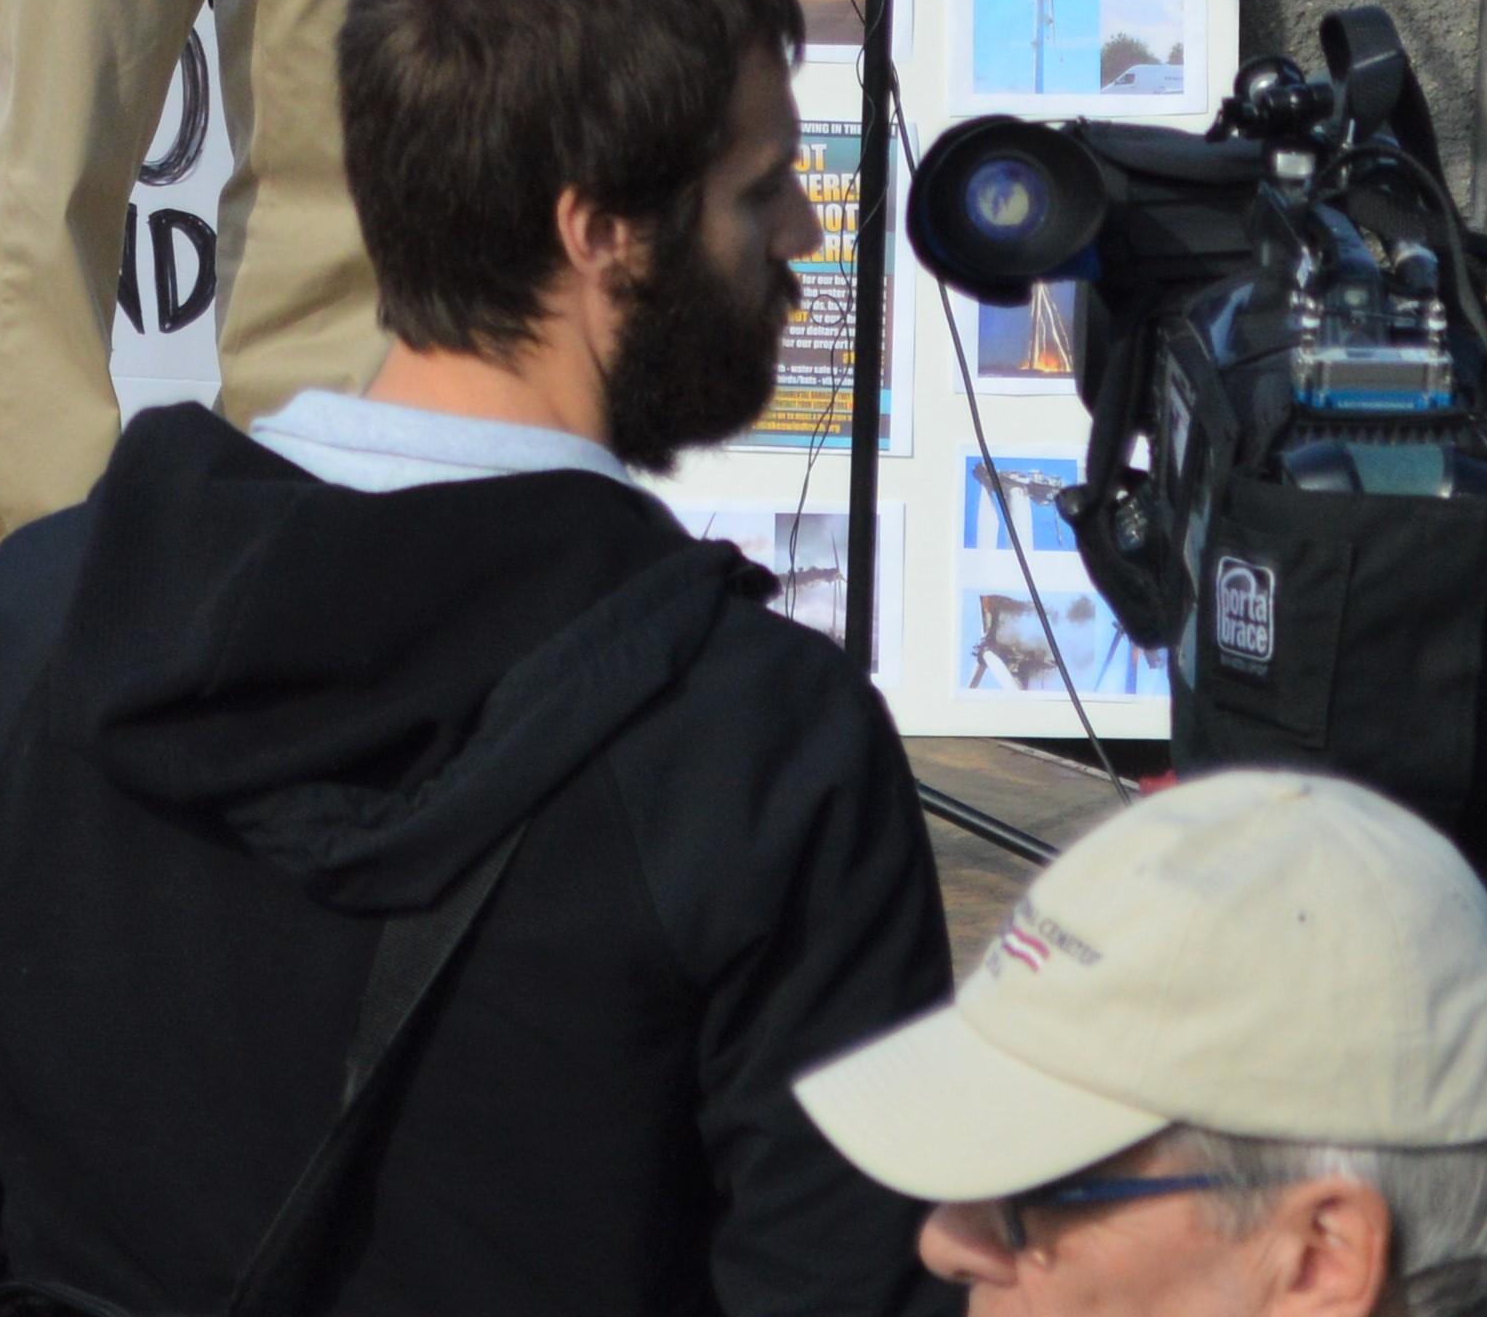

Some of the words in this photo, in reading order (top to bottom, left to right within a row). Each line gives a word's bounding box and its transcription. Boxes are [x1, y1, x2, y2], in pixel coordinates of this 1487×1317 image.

[801, 122, 829, 135] WING
[831, 123, 842, 134] IN
[794, 143, 827, 173] OT
[1221, 574, 1268, 623] porta
[1221, 619, 1268, 654] brace
